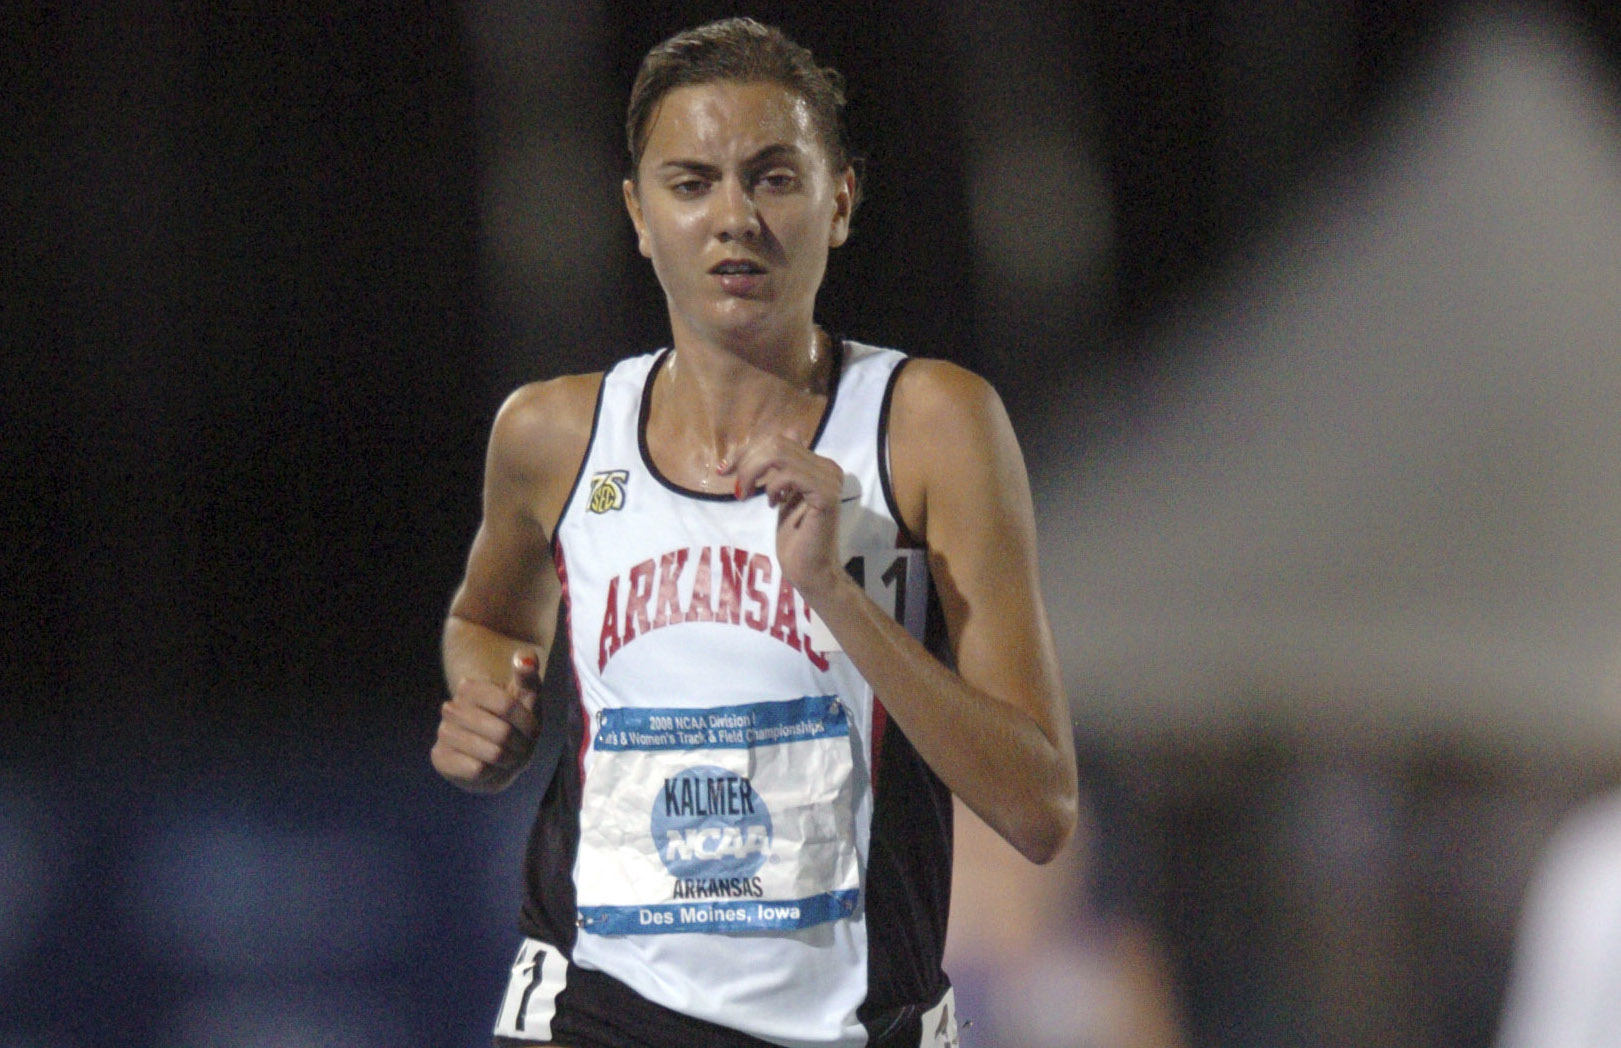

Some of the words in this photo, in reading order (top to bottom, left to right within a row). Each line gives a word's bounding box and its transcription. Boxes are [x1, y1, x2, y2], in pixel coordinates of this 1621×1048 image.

[629, 731, 676, 746] Women's
[676, 731, 706, 745] Track
[719, 729, 743, 743] Field
[746, 719, 825, 742] Championships
[675, 715, 708, 729] NCAA
[709, 713, 749, 728] Division
[664, 776, 755, 817] KALMER
[666, 825, 770, 861] NCAA
[673, 876, 764, 899] ARKANSAS
[639, 909, 674, 925] Des
[680, 906, 751, 923] Moines,
[758, 904, 801, 920] Iowa
